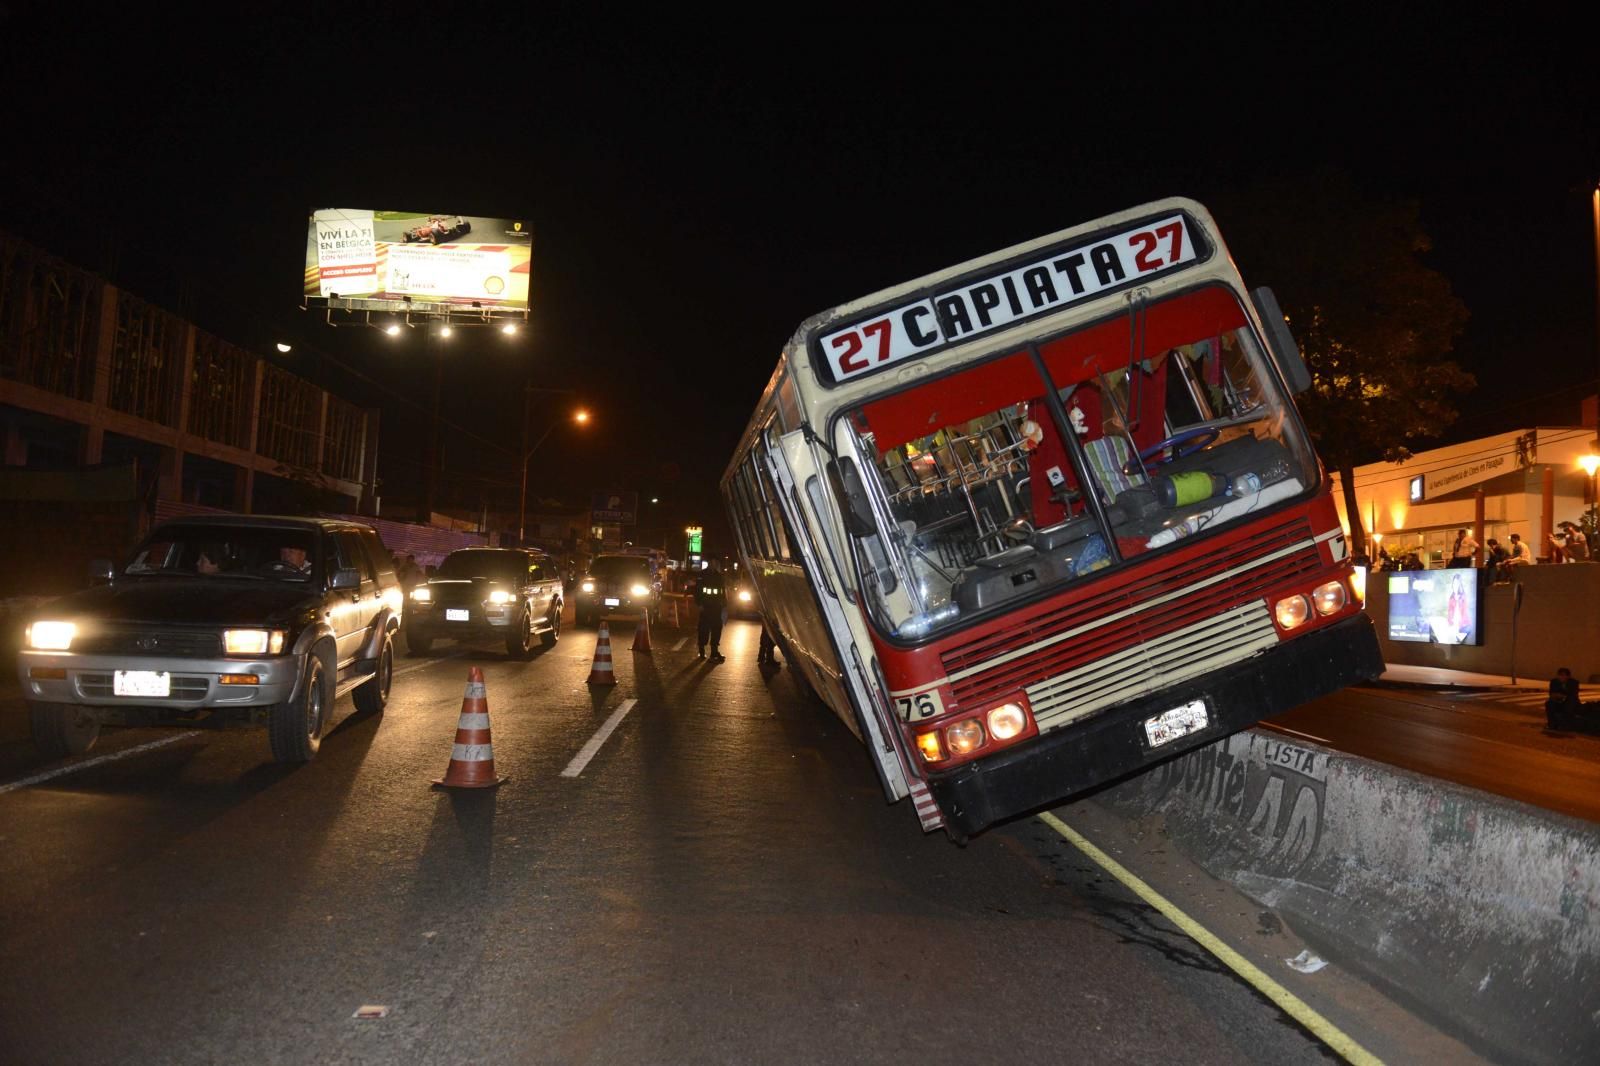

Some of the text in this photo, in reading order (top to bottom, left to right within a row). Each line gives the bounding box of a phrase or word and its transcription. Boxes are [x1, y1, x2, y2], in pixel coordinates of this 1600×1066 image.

[319, 227, 372, 240] VIVÍ LA F1
[320, 242, 333, 250] EN
[831, 220, 1184, 375] 27 CAPIATA 27
[899, 694, 936, 721] 76
[1264, 741, 1315, 773] LISTA
